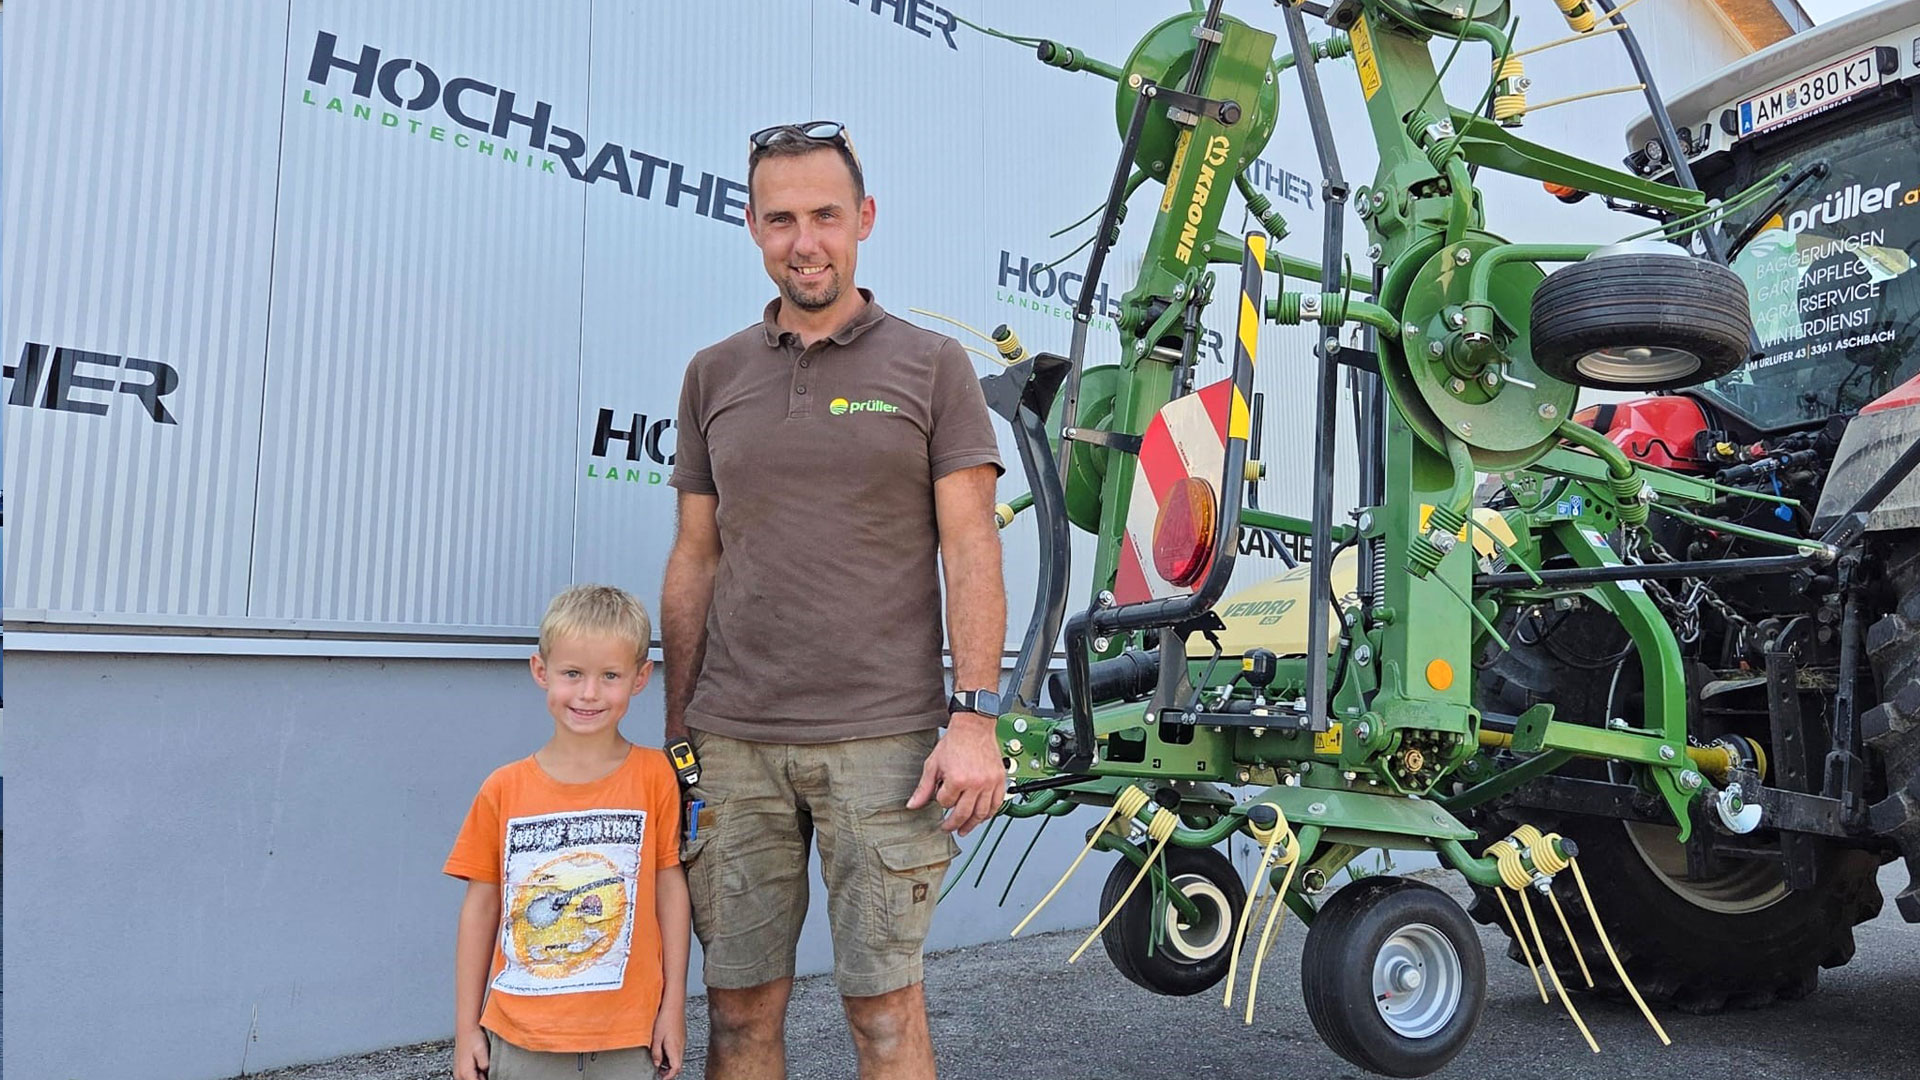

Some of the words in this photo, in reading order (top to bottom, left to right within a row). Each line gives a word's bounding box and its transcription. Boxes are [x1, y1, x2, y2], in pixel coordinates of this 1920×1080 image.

[1757, 93, 1783, 124] AM
[1800, 72, 1838, 106] 380
[1844, 58, 1871, 90] KJ
[303, 89, 556, 174] LANDTECHNIK
[307, 30, 748, 227] HOCHRATHE
[1762, 96, 1851, 134] www.hochrather.at
[1175, 164, 1215, 264] KRONE
[1787, 181, 1920, 246] prüller.a
[1756, 228, 1884, 280] BAGGERUNGEN
[1757, 256, 1880, 302] GARTENPFLEGE
[996, 291, 1112, 332] LANDTECNIK
[1756, 284, 1880, 325] AGRARSERVICE
[1760, 308, 1871, 349] WINTERDIENST
[1745, 359, 1758, 371] AM
[1759, 351, 1793, 368] URLUFER
[1794, 348, 1806, 359] 43
[1810, 342, 1832, 356] 3361
[1835, 330, 1895, 351] ASCHBACH
[849, 400, 899, 414] prüller
[592, 407, 677, 466] HO
[588, 464, 671, 485] LAND
[1221, 599, 1296, 618] VENDRO
